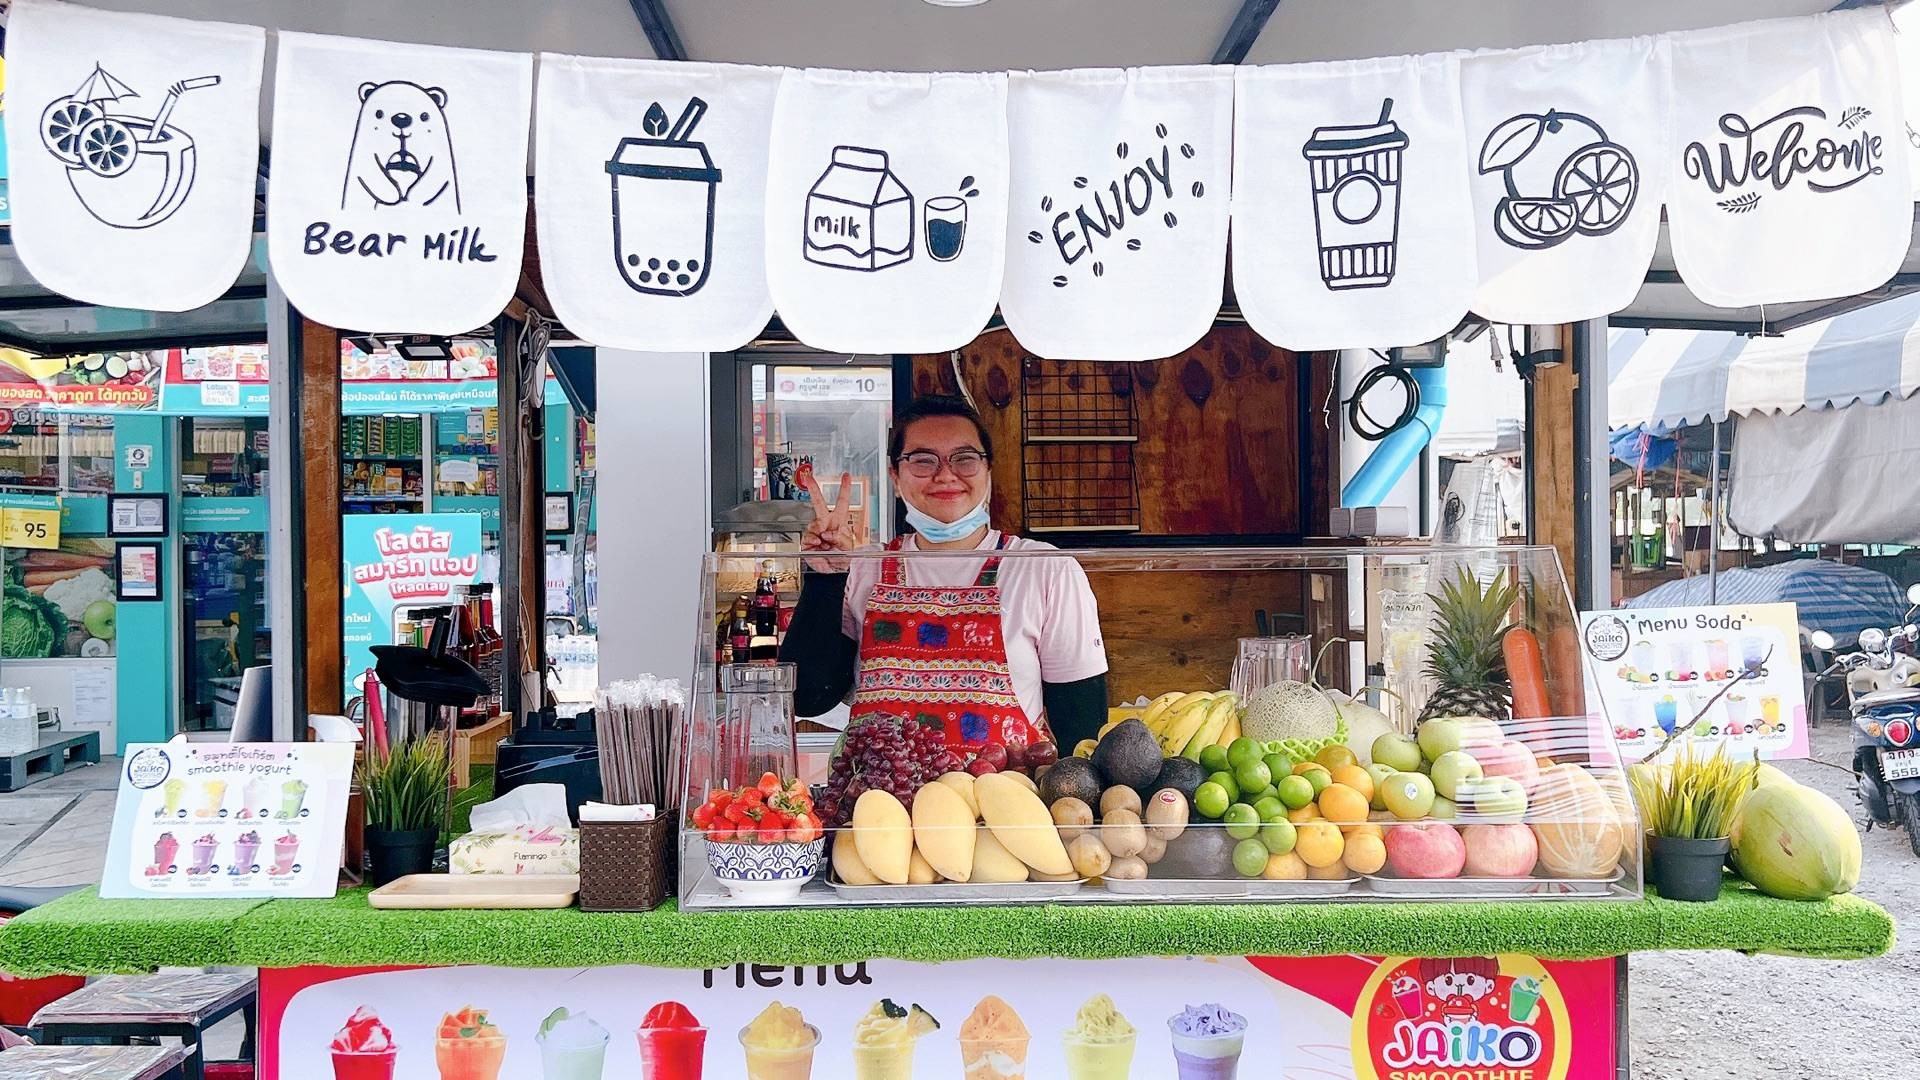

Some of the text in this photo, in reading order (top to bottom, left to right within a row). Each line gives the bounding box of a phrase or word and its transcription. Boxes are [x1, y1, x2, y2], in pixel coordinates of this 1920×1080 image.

[1684, 106, 1884, 193] Welcome
[1052, 145, 1173, 265] ENJOY
[814, 216, 861, 239] Milk
[304, 222, 497, 263] Bear Milk
[98, 387, 148, 404] ได้ทุกวัน
[855, 378, 875, 393] 10
[25, 523, 46, 538] 95
[375, 526, 451, 555] โลตัส
[354, 553, 478, 583] สมาร์ท แอป
[390, 581, 449, 598] โหลดเลย
[1638, 613, 1742, 635] Menu Soda
[187, 761, 292, 776] smoothie yogurt
[513, 851, 548, 860] Flamingo
